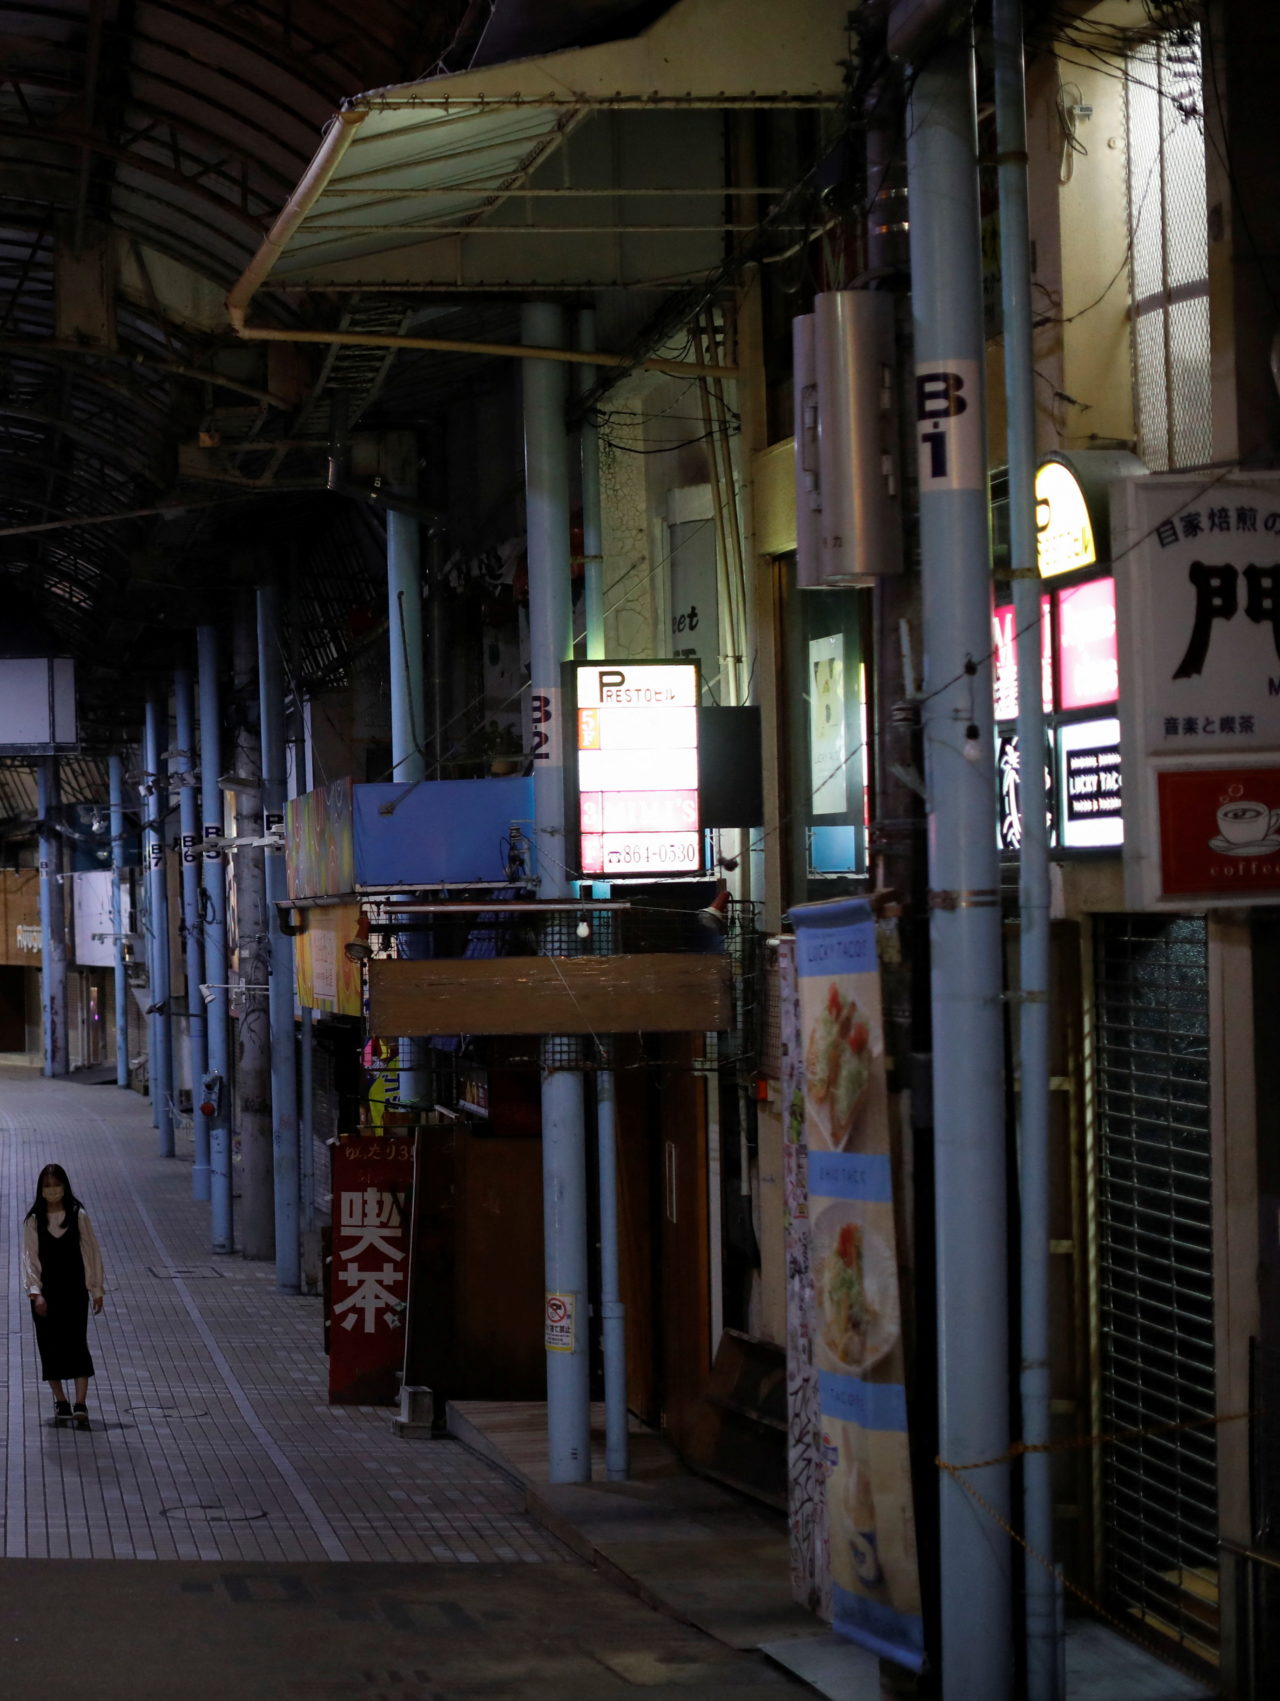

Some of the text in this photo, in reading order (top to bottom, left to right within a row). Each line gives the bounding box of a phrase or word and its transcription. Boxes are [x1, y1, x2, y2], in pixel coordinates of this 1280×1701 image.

[1164, 714, 1255, 736] 音楽と喫茶
[623, 843, 696, 864] 864-0530
[332, 1189, 405, 1334] 喫茶
